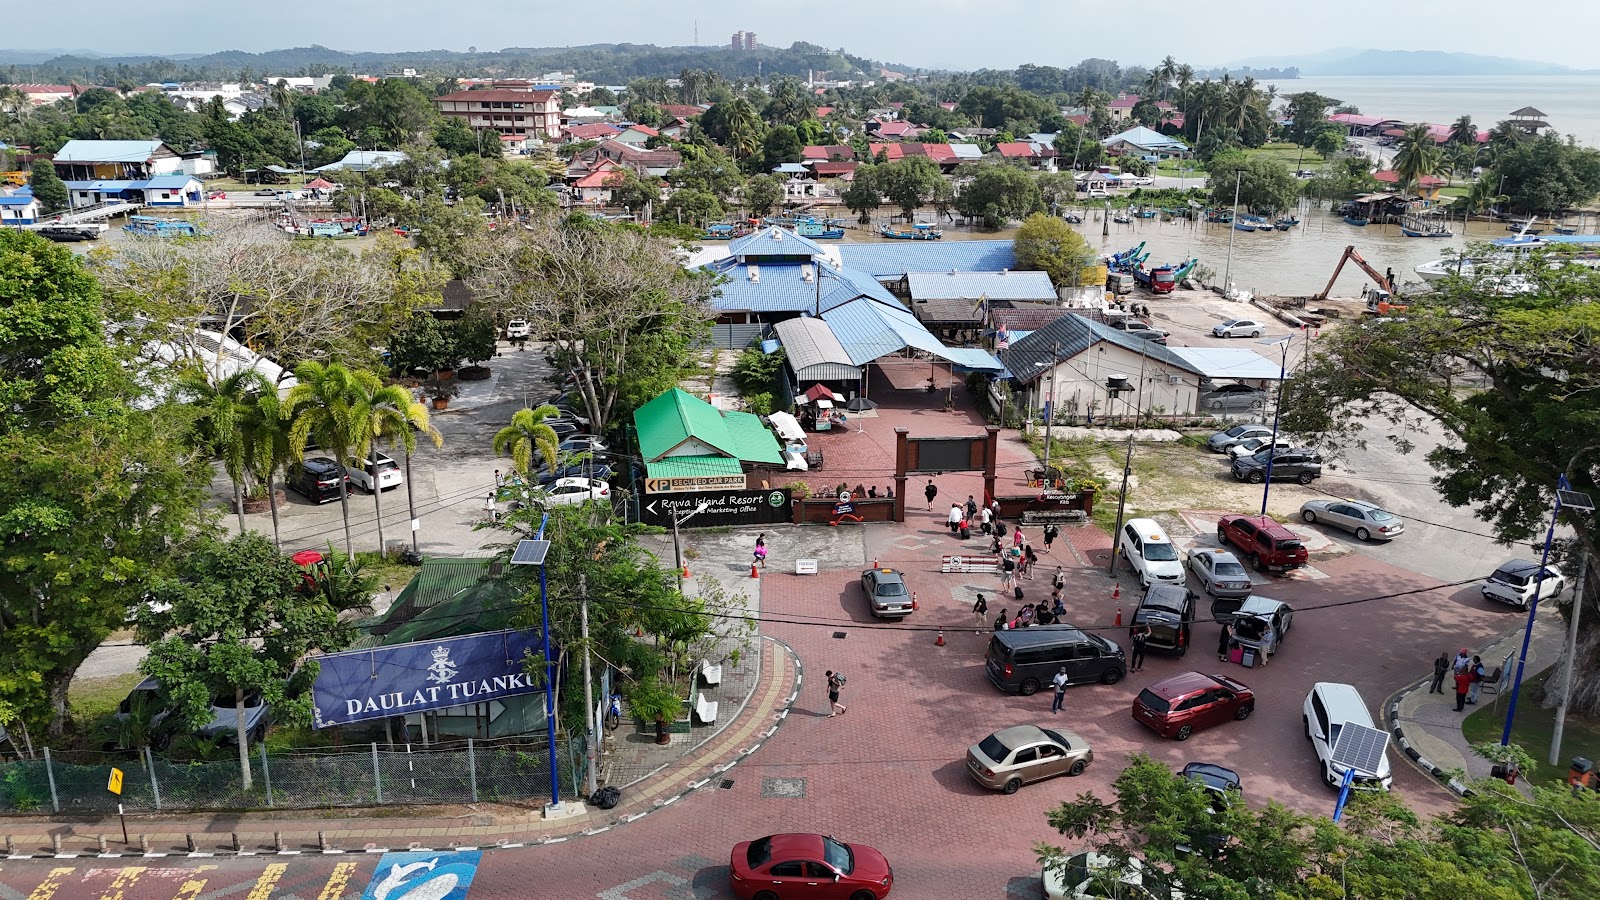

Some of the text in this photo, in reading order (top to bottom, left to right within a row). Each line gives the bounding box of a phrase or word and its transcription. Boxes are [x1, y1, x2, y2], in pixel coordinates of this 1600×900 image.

[674, 476, 743, 486] SECURED CAR PARK
[661, 494, 764, 508] Rawa Island Resort
[667, 508, 699, 517] Rception
[706, 506, 738, 516] Marketing
[739, 505, 757, 513] Office
[346, 686, 441, 716] DAULAT
